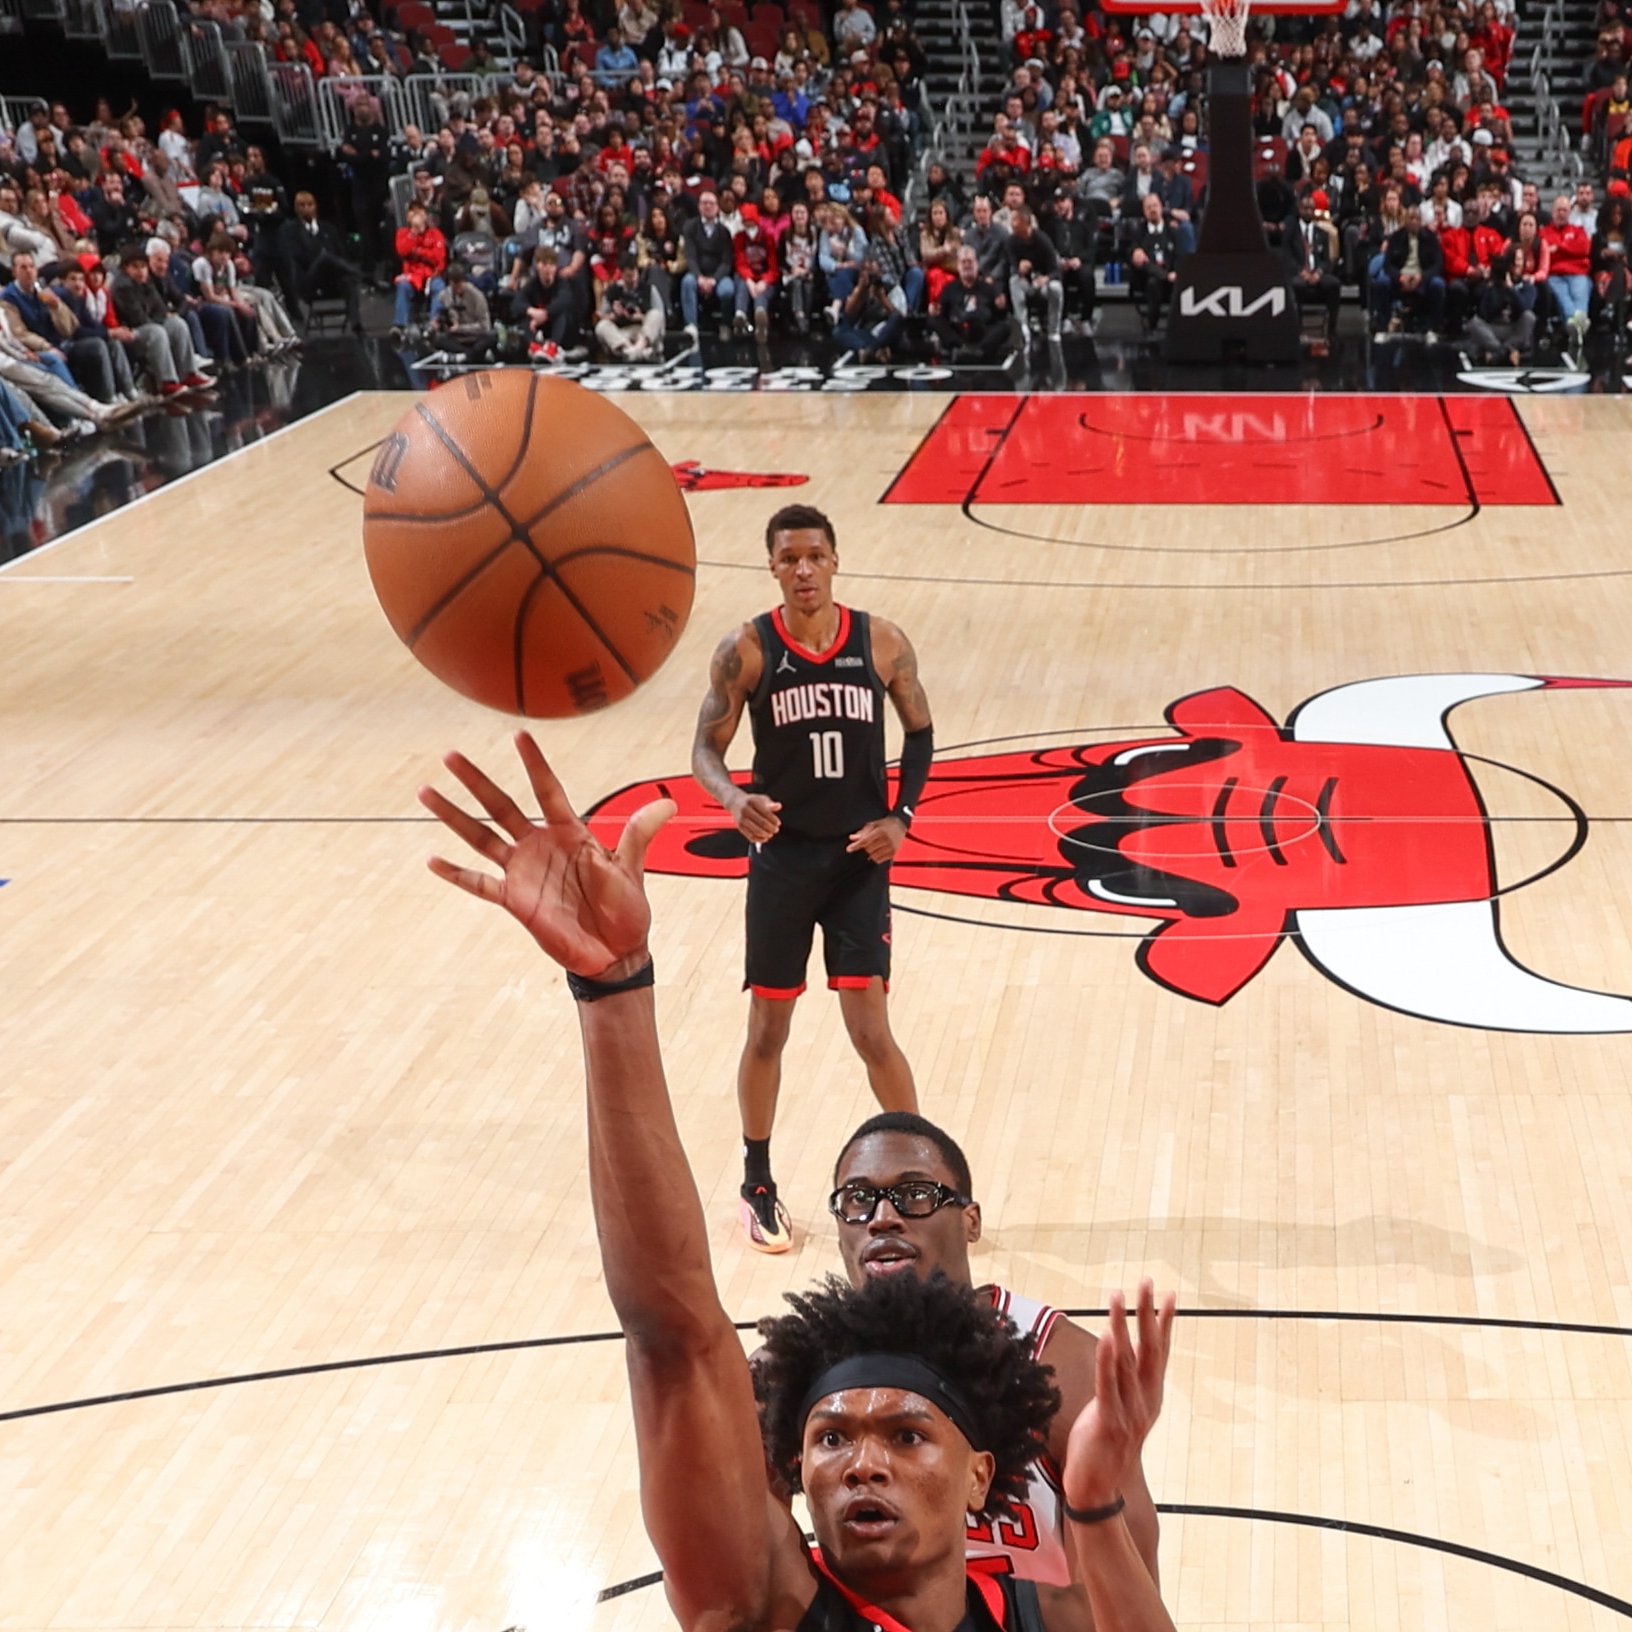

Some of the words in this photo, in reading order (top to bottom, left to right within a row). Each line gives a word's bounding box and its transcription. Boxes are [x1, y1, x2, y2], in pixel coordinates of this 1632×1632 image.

[1180, 285, 1286, 317] KIA
[771, 683, 874, 727] HOUSTON
[809, 731, 844, 778] 10
